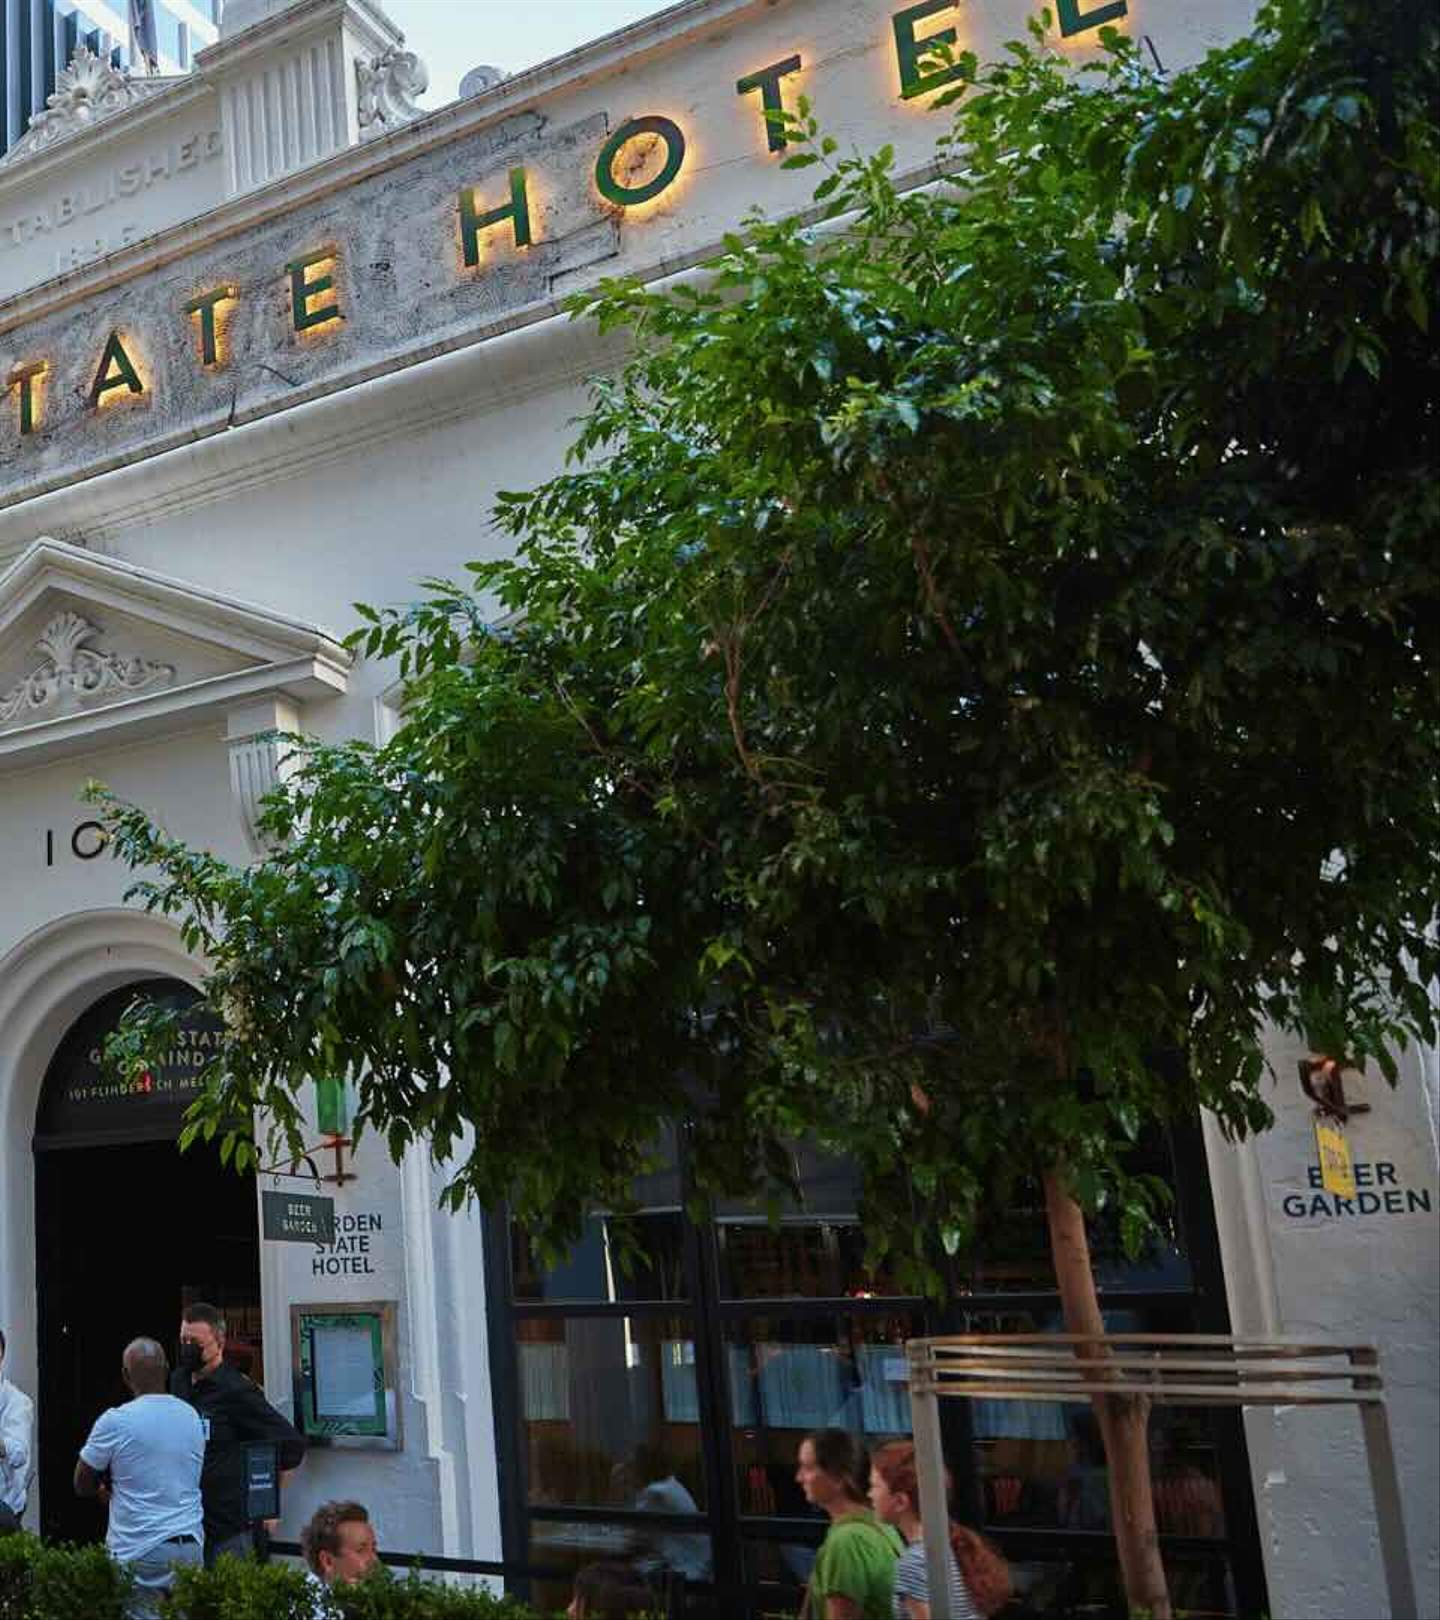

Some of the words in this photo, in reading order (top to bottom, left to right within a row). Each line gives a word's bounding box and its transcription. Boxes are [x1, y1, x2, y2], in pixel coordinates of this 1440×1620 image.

[46, 820, 105, 867] 10
[1307, 1162, 1397, 1189] BER
[1282, 1188, 1432, 1218] GARDEN
[335, 1213, 382, 1232] RDEN
[312, 1257, 375, 1276] HOTEL
